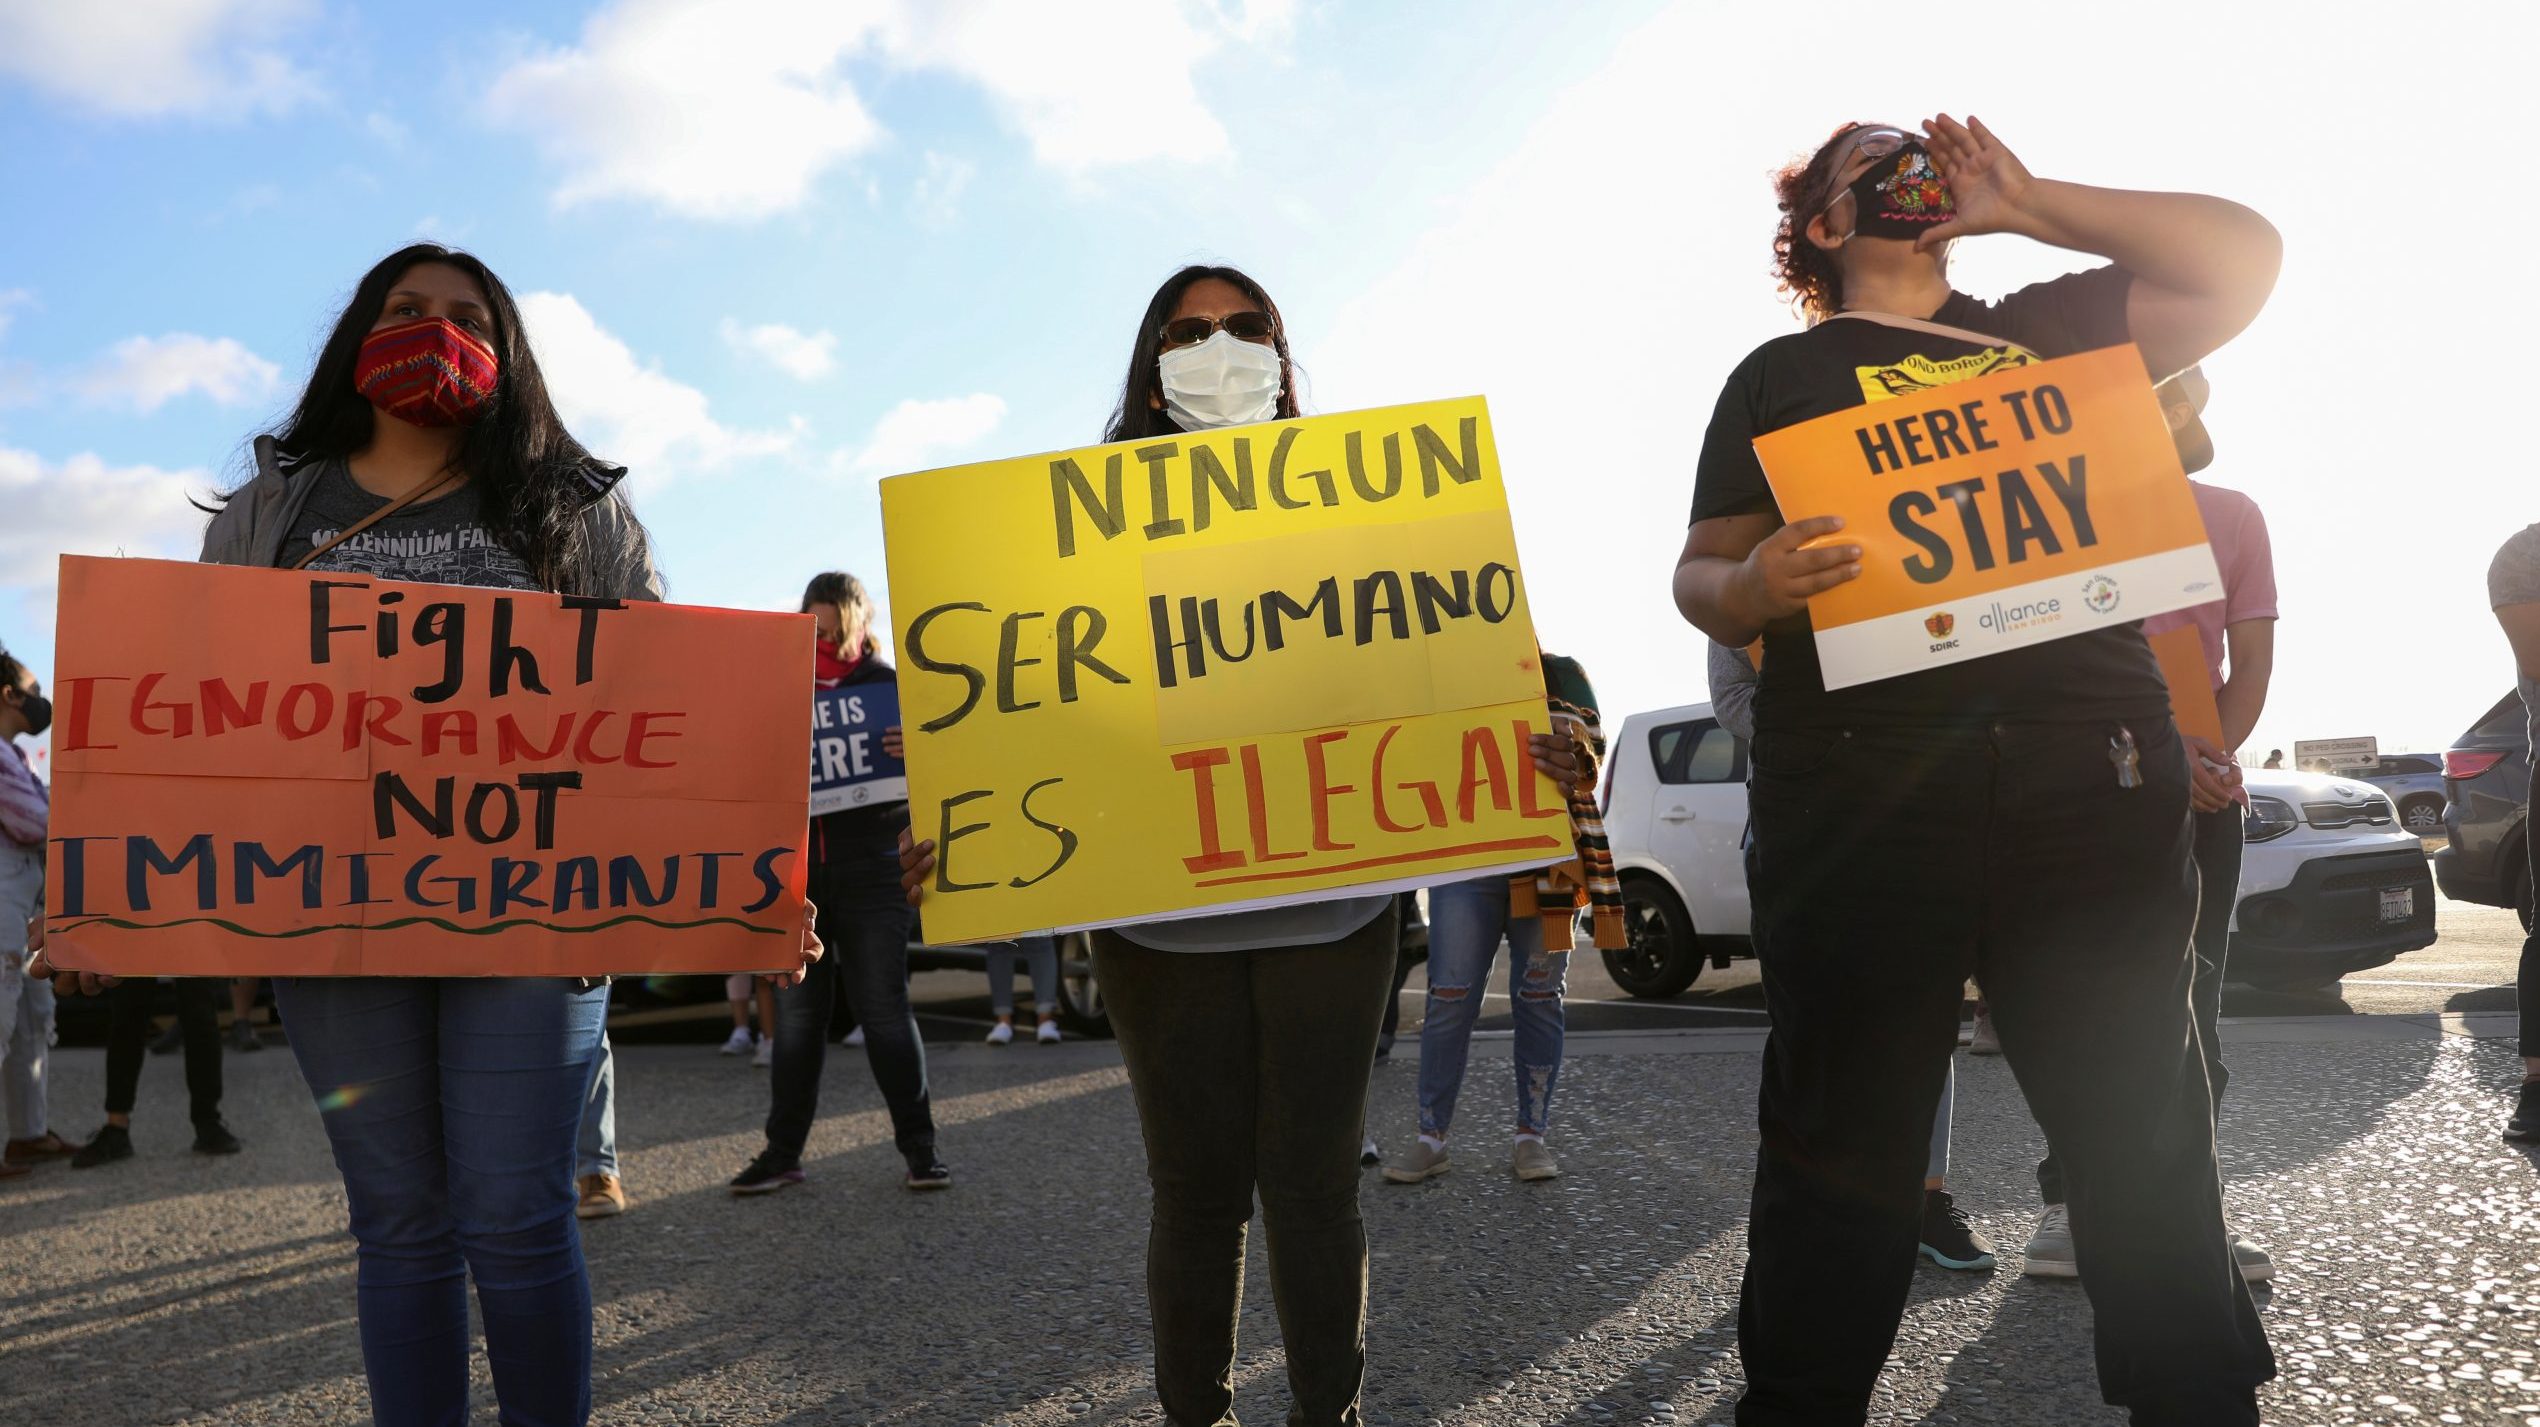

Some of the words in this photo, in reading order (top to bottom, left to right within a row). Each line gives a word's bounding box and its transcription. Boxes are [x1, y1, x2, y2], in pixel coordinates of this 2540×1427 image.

[1854, 400, 1998, 475] HERE
[2001, 384, 2073, 441] TO
[1049, 417, 1481, 558] NINGUN
[1888, 454, 2098, 585] STAY
[905, 601, 1130, 734] SER
[1149, 562, 1516, 688] HUMANO
[1929, 639, 1960, 653] SDIRC
[1979, 598, 2061, 634] alliance
[57, 673, 687, 769] IGNORANCE
[838, 696, 866, 726] IS
[374, 771, 583, 850] NOT
[935, 778, 1078, 892] ES
[1171, 720, 1566, 874] ILEGAL
[48, 834, 795, 919] IMMIGRANTS
